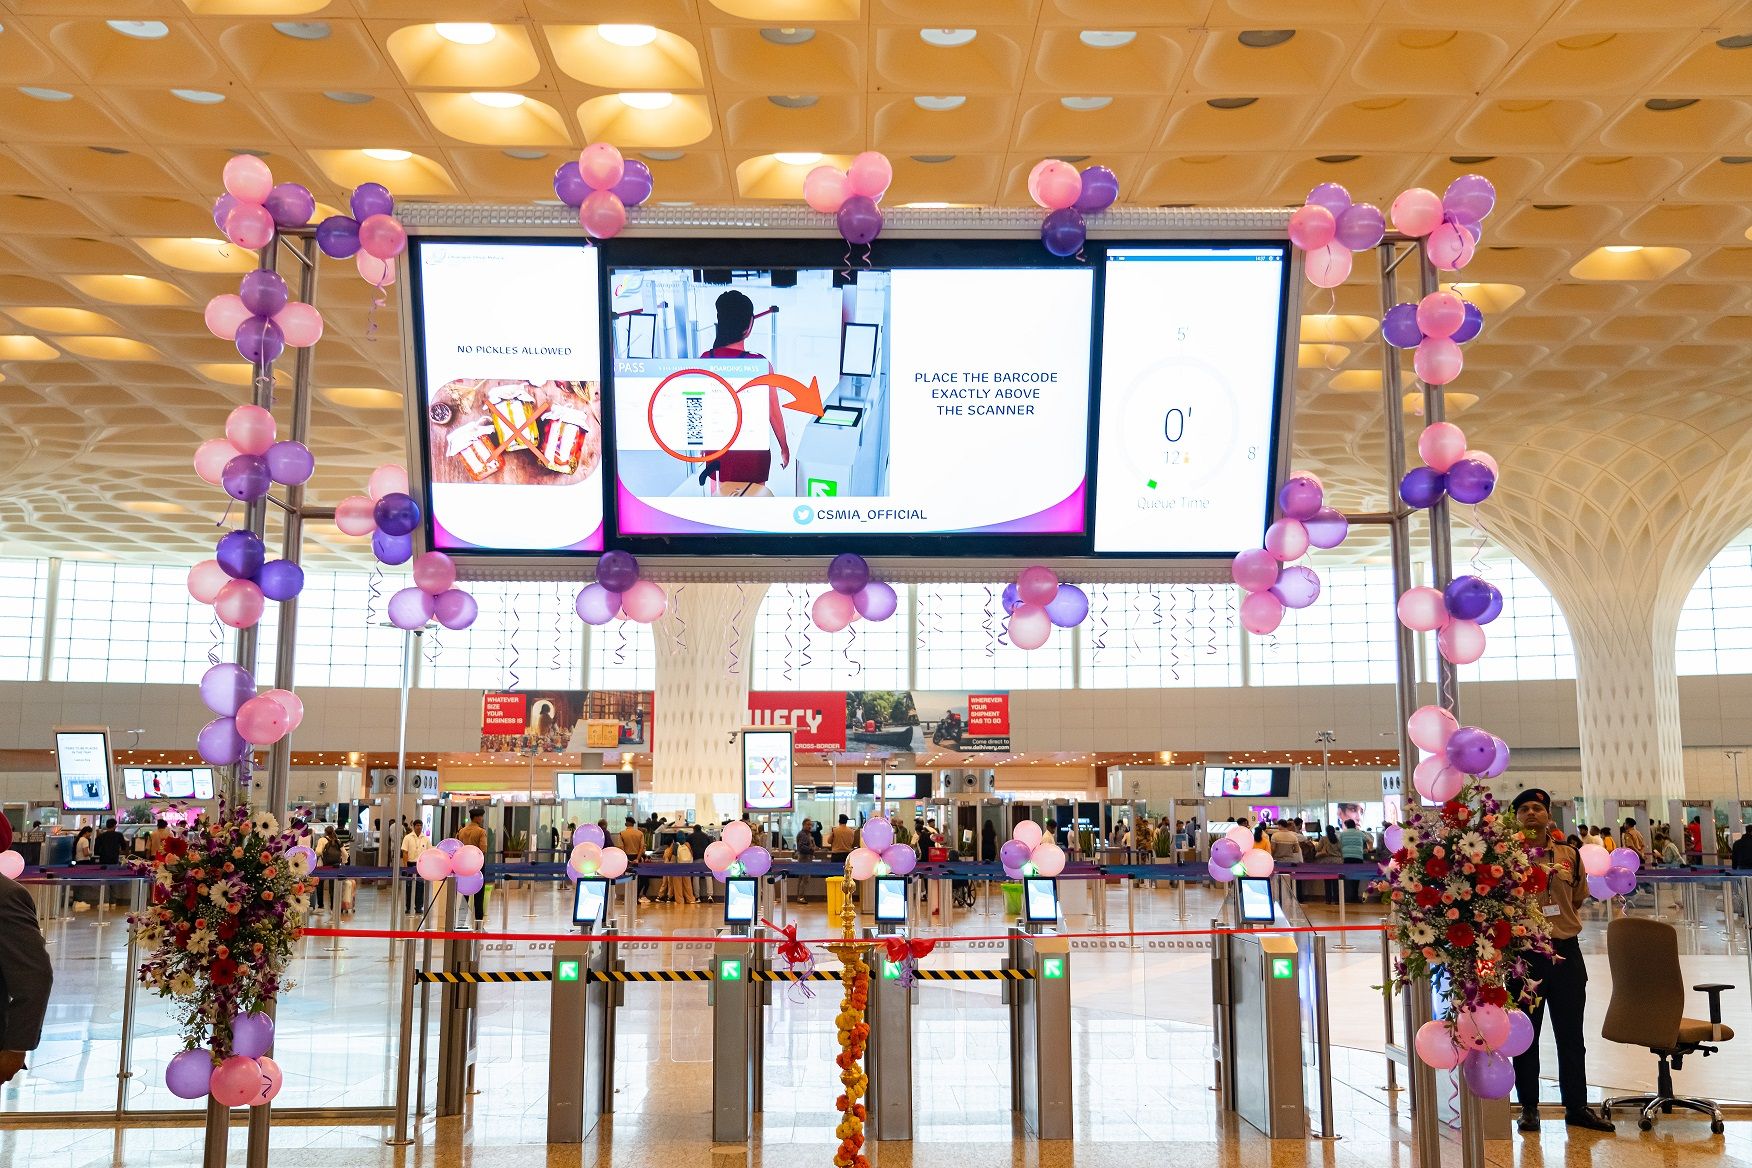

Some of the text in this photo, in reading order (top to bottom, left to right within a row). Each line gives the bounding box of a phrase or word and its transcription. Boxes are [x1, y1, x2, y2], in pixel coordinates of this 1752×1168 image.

[457, 345, 572, 356] NO PICKLES ALLOWED
[618, 362, 645, 373] PASS
[914, 372, 1058, 383] PLACE THE BARCODE
[931, 388, 1040, 399] EXACTLY ABOVE
[936, 404, 1035, 416] THE SCANNER
[1137, 496, 1210, 512] Queue Time
[817, 509, 928, 523] CSMIA_OFFICIAL
